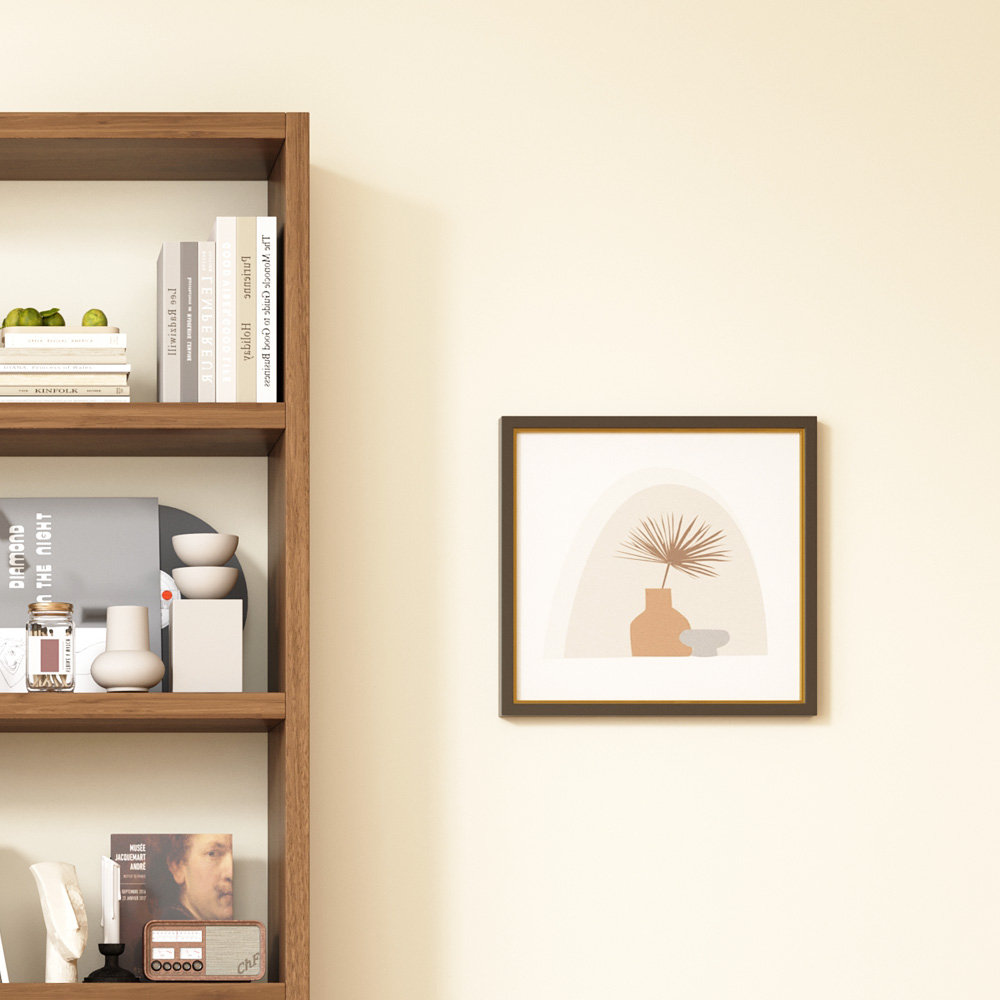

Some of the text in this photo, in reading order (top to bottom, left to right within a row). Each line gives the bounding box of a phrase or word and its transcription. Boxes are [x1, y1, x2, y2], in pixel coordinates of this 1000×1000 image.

[36, 512, 52, 556] NIGHT
[8, 524, 25, 589] DIAMOND
[36, 564, 52, 589] THE
